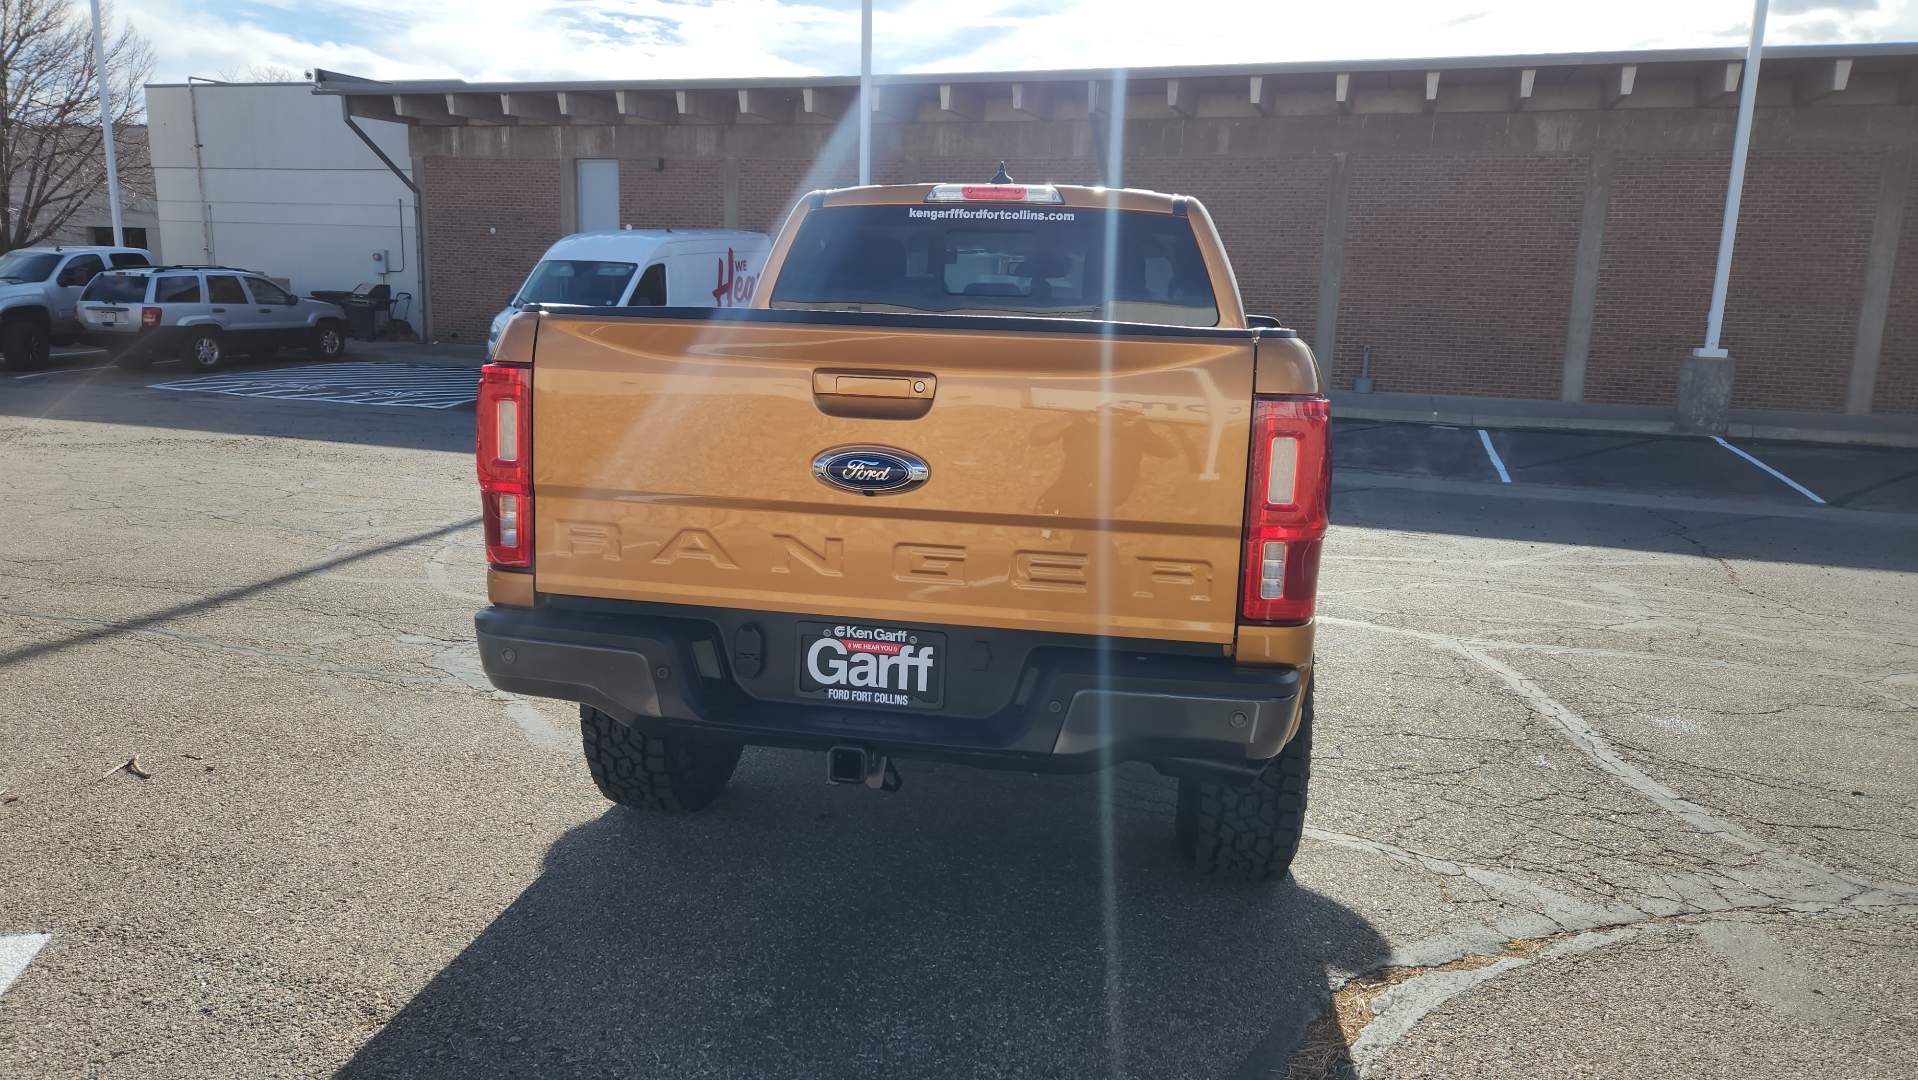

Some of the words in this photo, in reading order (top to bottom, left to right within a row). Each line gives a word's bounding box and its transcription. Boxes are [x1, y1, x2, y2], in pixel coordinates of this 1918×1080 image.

[909, 208, 1075, 221] kengarfffordfortcollins.com
[735, 260, 747, 272] WE
[712, 247, 760, 307] Hea
[842, 459, 891, 481] Ford
[554, 517, 1213, 602] RANGER
[846, 626, 873, 639] Ken
[874, 628, 908, 643] Garff
[863, 643, 880, 651] HEAR
[807, 638, 934, 692] Garff
[828, 688, 850, 701] FORD
[851, 690, 873, 703] FORT
[874, 693, 909, 706] COLLINS
